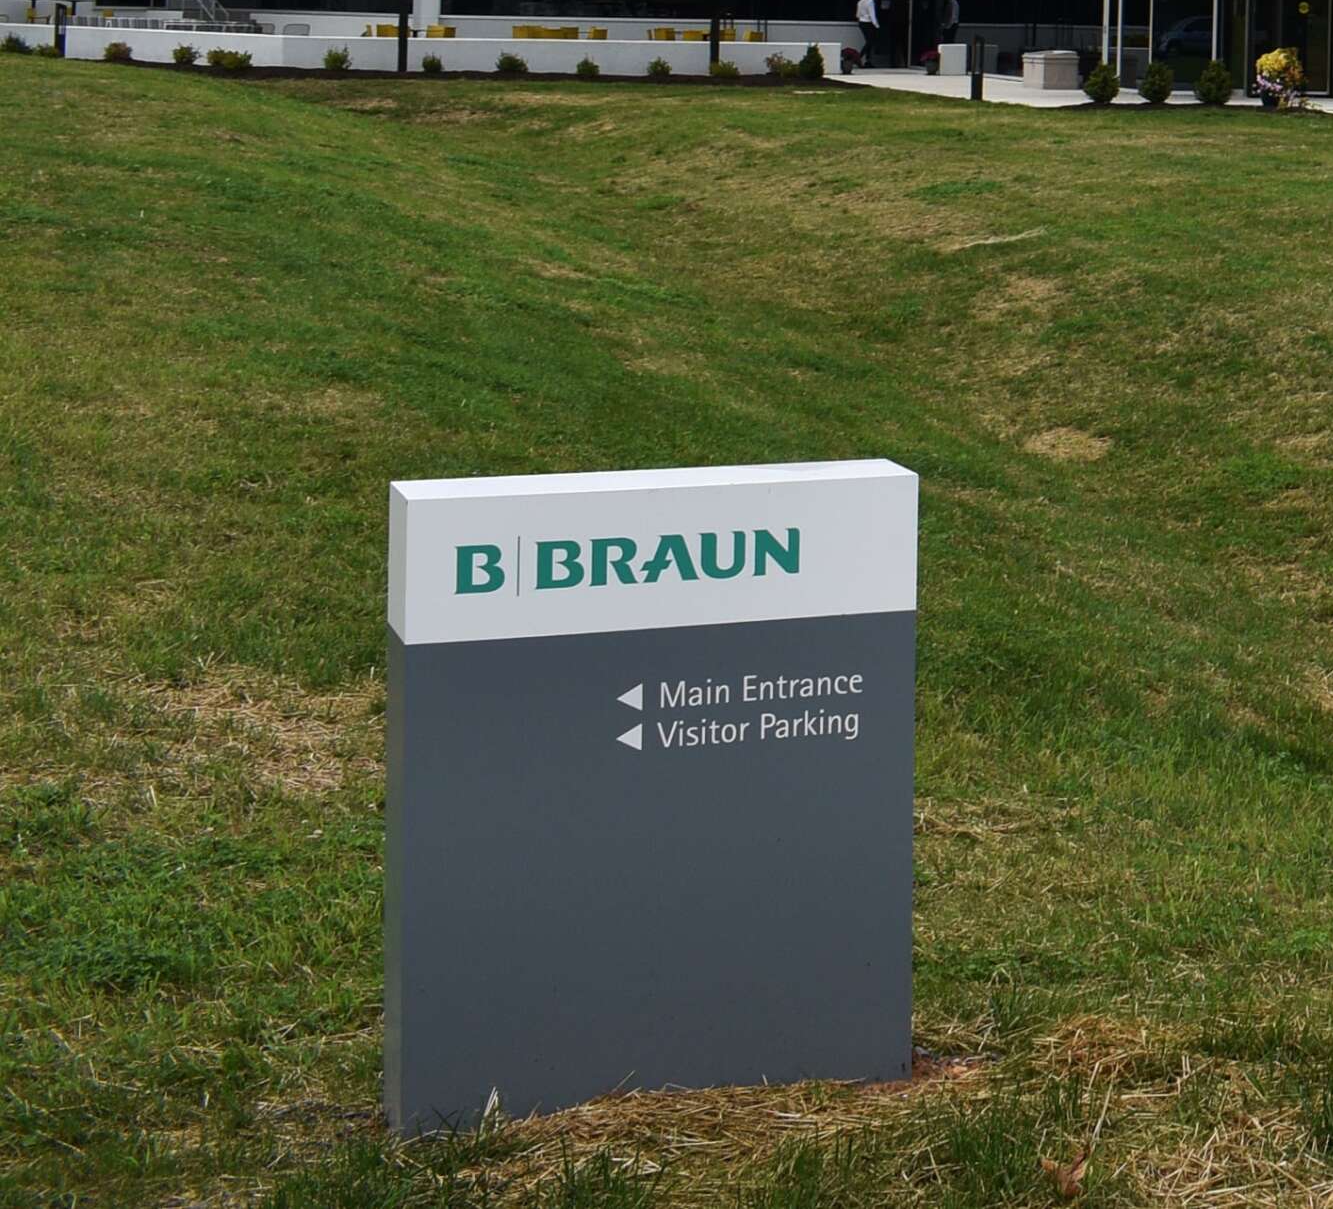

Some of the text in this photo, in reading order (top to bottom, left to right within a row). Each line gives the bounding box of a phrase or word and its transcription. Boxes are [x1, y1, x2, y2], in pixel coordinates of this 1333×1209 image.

[454, 527, 801, 595] B BRAUN
[659, 673, 864, 709] Main Entrance
[656, 709, 860, 749] Visitor Parking
